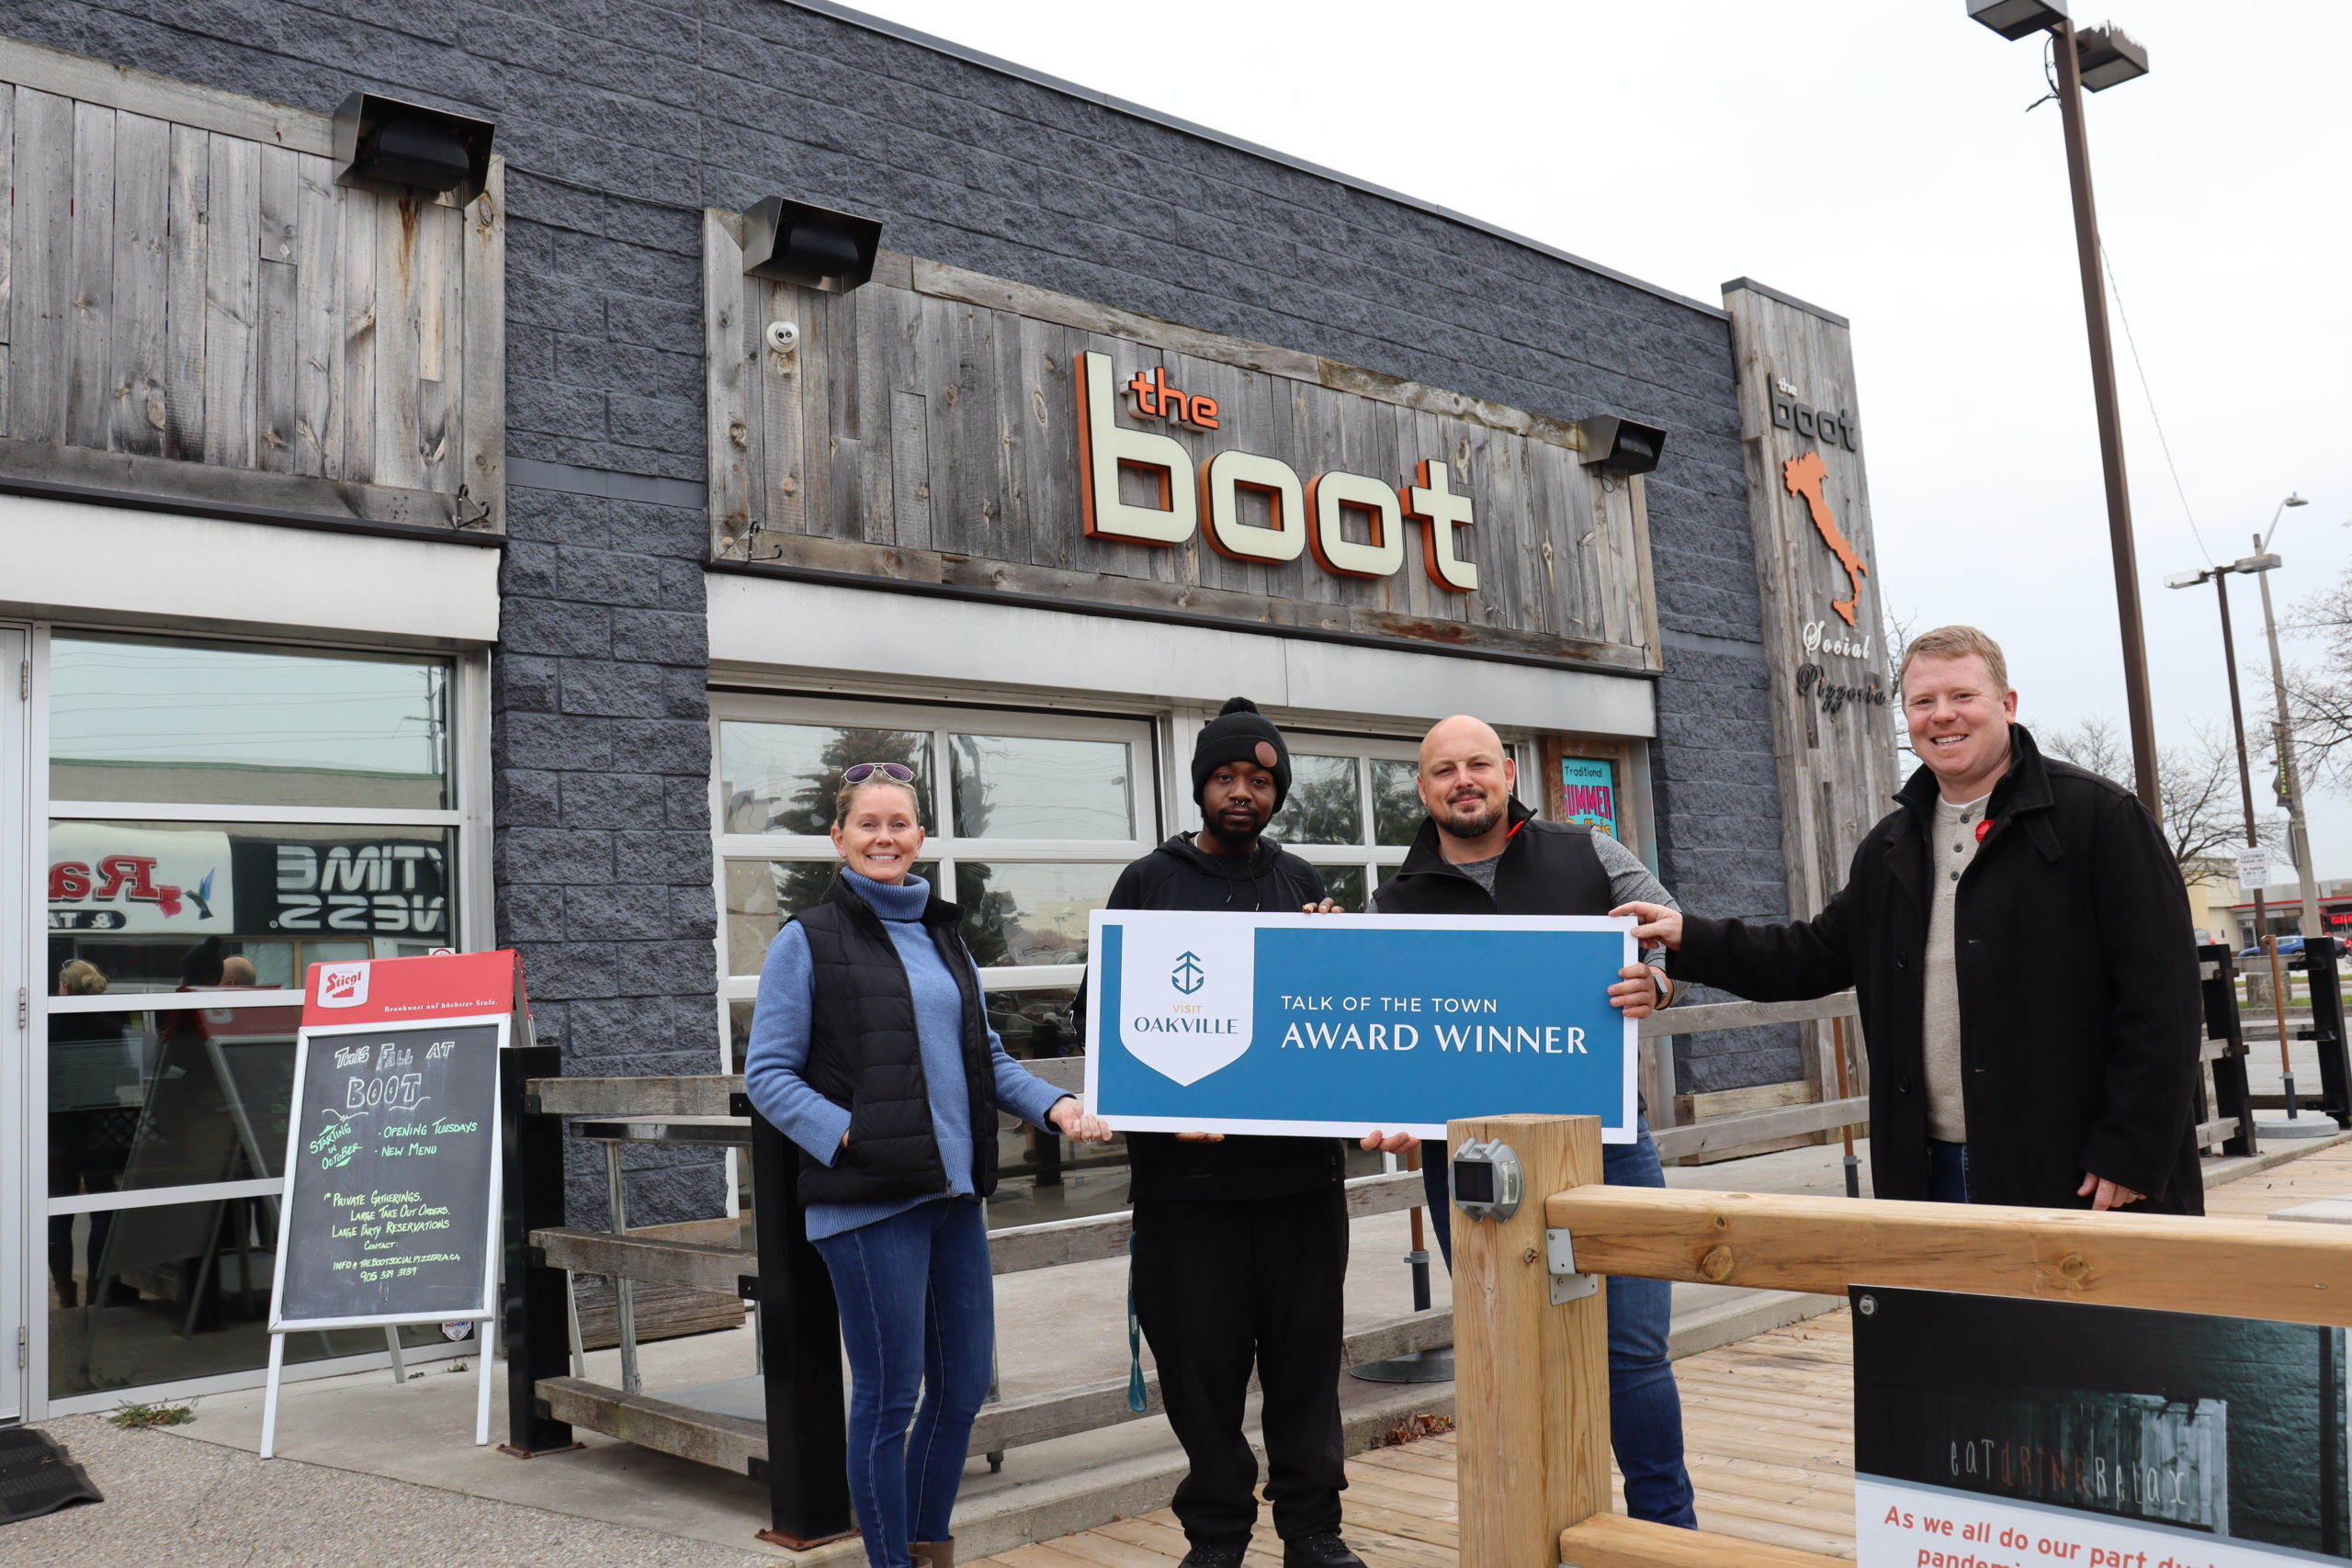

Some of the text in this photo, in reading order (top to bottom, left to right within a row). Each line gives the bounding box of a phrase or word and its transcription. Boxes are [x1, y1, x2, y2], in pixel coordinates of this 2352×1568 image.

[1777, 377, 1798, 396] the
[1126, 367, 1221, 432] the
[1768, 372, 1857, 453] boot
[1075, 350, 1478, 593] boot
[1803, 620, 1871, 660] Social
[1565, 765, 1603, 778] Traditional
[325, 971, 362, 994] Stiegl
[384, 1005, 424, 1013] Braukunst
[441, 1000, 473, 1009] höchster
[475, 998, 498, 1007] Stufe.
[1172, 1005, 1203, 1014] VISIT
[1281, 995, 1498, 1013] TALK OF THE TOWN
[1134, 1016, 1238, 1034] OAKVILLE
[1281, 1021, 1589, 1055] AWARD WINNER
[375, 1043, 413, 1071] FALL
[426, 1041, 456, 1058] AT
[346, 1073, 423, 1109] BOOT
[310, 1122, 352, 1155] STARTING
[383, 1122, 427, 1139] OPENING
[322, 1142, 364, 1169] OCTOBER
[327, 1145, 337, 1155] IN
[381, 1143, 437, 1157] NEW MENU
[333, 1192, 366, 1207] PRIVATE
[350, 1210, 376, 1222] LARGE
[379, 1204, 399, 1219] TAKE
[400, 1204, 417, 1217] OUT
[332, 1219, 450, 1240] LARGE PARTY RESERVATIONS
[360, 1270, 378, 1283] 905
[1884, 1506, 1914, 1529] As
[1923, 1516, 1954, 1537] we
[1962, 1521, 1991, 1544] all
[1999, 1527, 2029, 1551] do
[2038, 1538, 2081, 1560] our
